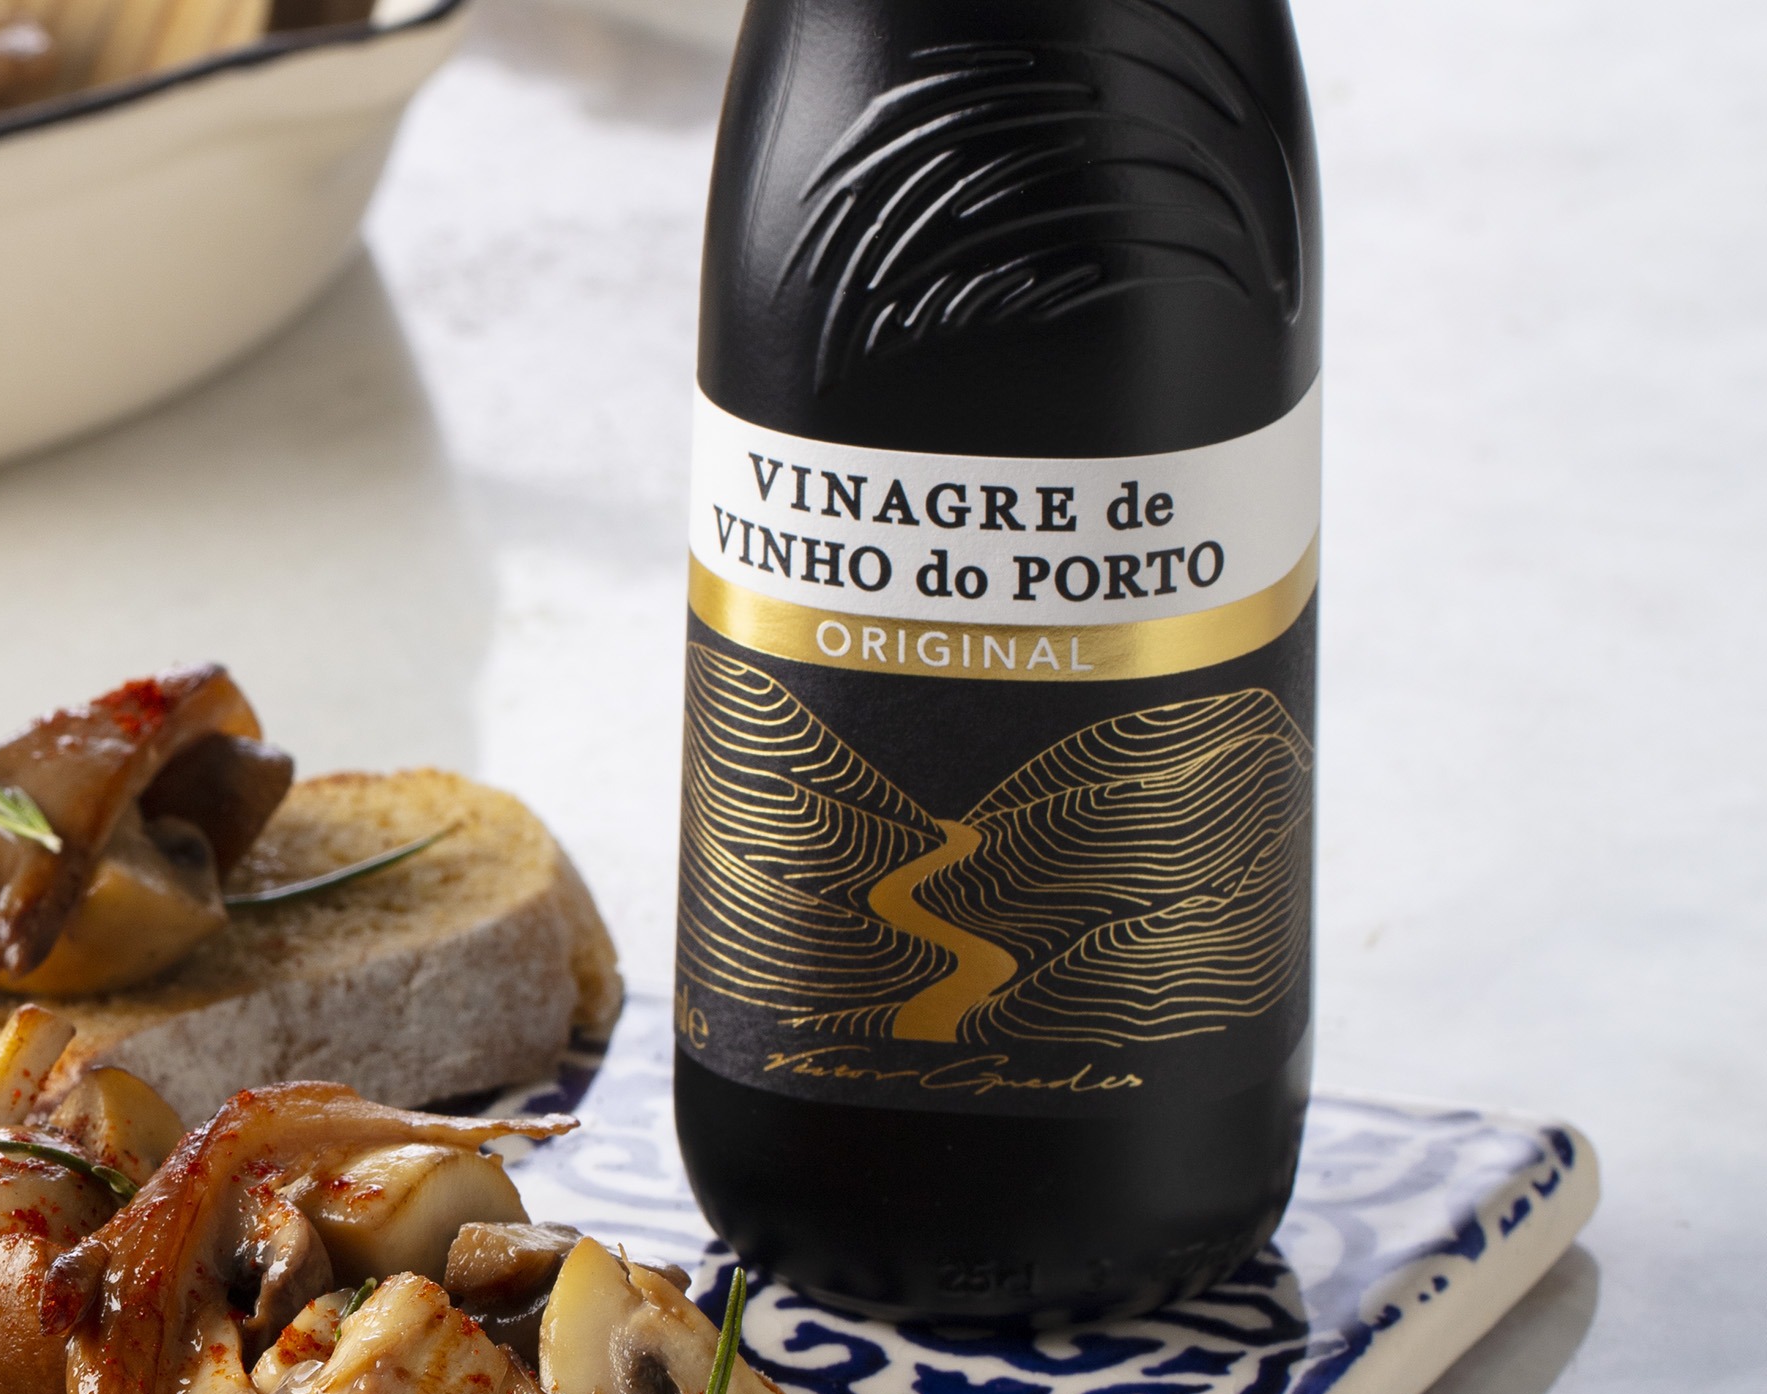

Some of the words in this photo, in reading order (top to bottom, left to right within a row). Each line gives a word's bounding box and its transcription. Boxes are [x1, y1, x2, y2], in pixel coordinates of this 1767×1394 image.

[747, 451, 1078, 533] VINAGRE
[1105, 480, 1176, 531] de
[711, 503, 894, 593] VINHO
[916, 549, 989, 600] do
[1012, 539, 1226, 602] PORTO
[815, 619, 1096, 673] ORIGINAL
